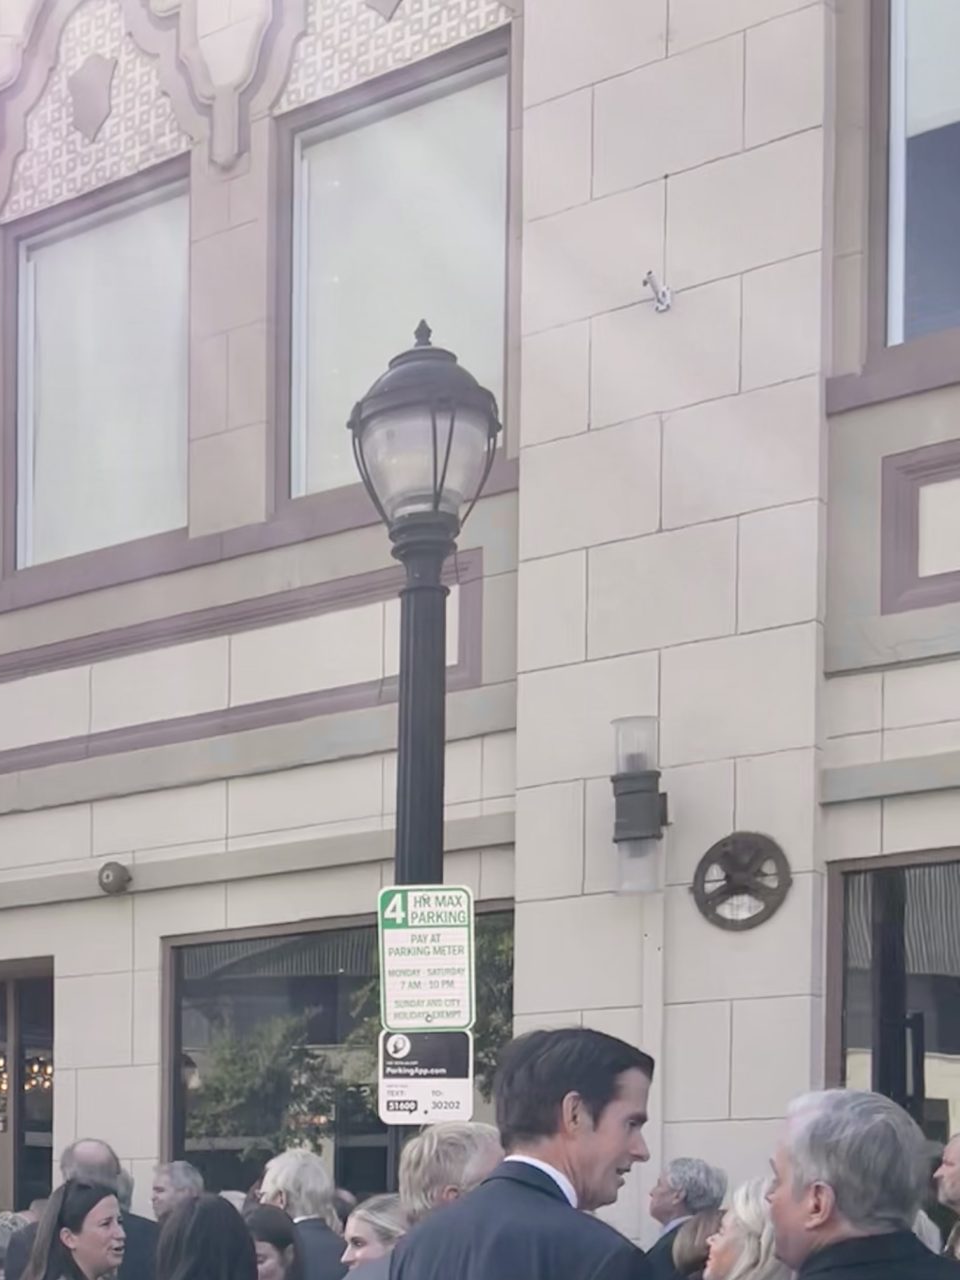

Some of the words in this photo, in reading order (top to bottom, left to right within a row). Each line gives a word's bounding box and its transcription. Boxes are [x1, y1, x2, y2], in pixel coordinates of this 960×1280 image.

[413, 895, 431, 908] HR
[435, 895, 463, 907] MAX
[384, 893, 406, 925] 4
[411, 910, 466, 924] PARKING
[410, 933, 428, 944] PAY
[430, 933, 441, 943] AT
[388, 946, 430, 957] PARKING
[433, 945, 465, 956] METER
